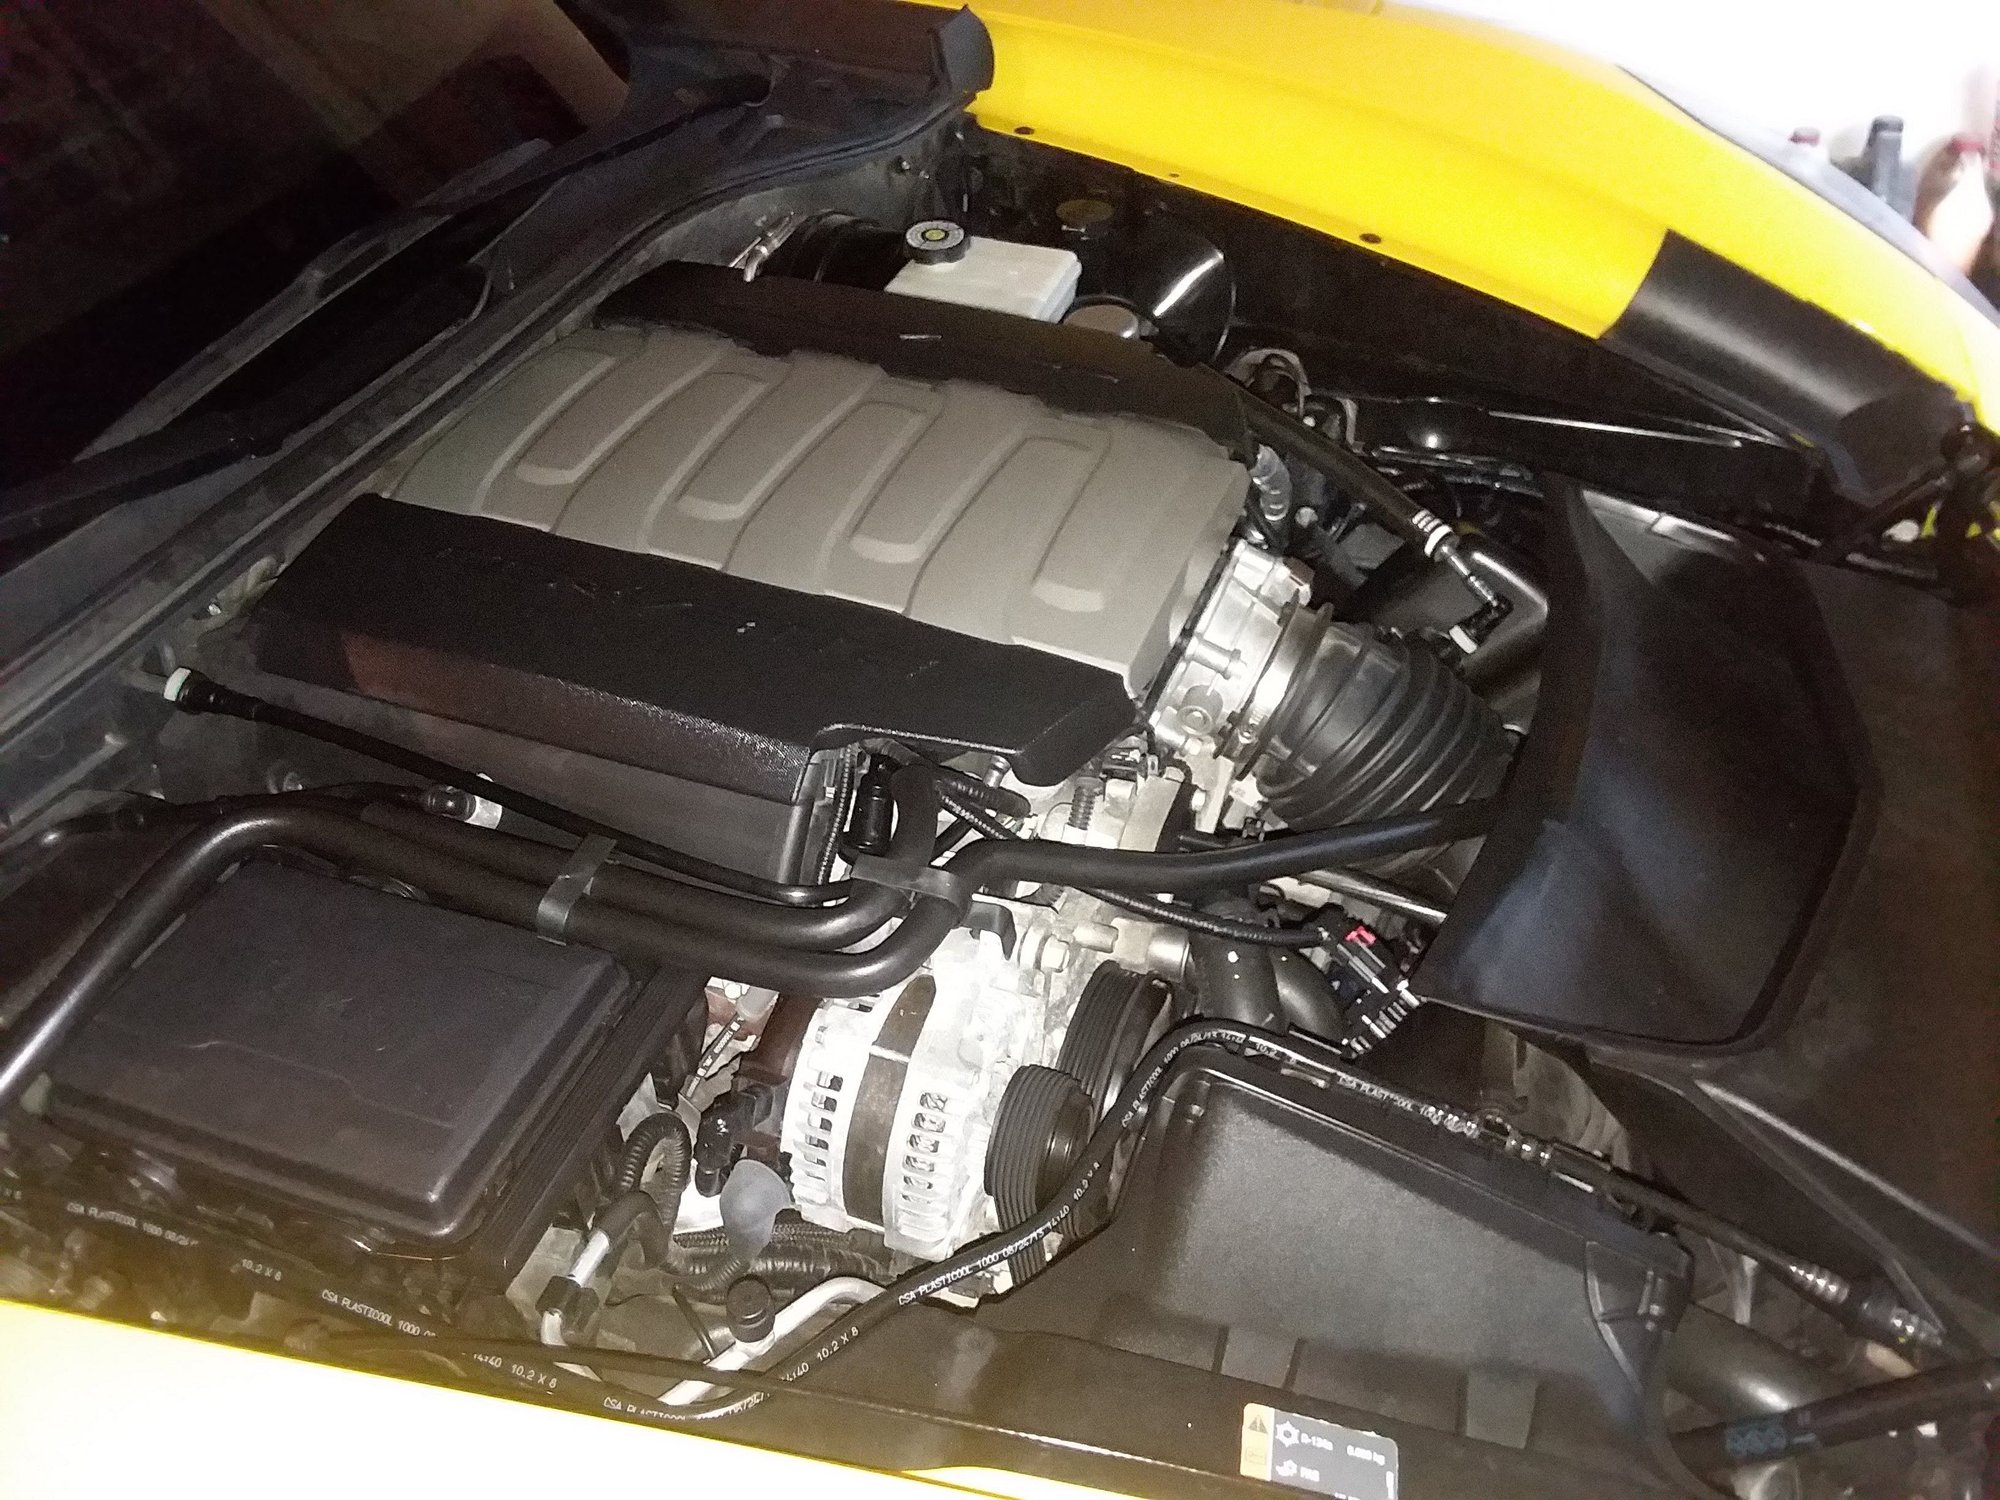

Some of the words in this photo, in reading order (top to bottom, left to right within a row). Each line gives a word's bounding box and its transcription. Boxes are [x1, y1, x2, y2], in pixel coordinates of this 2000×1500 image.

[241, 1258, 263, 1274] 10.2
[899, 1292, 916, 1306] CSA
[919, 1264, 974, 1296] PLASTICOOL
[977, 1252, 1000, 1271] 1000
[321, 1289, 339, 1304] CSA
[341, 1297, 393, 1327] PLASTICOOL
[398, 1320, 421, 1336] 1000
[815, 1340, 840, 1361] 10.2
[840, 1333, 850, 1345] X
[851, 1326, 859, 1337] 8
[511, 1364, 536, 1381] 10.2
[537, 1373, 547, 1386] X
[548, 1378, 558, 1389] 8
[603, 1396, 623, 1411] CSA
